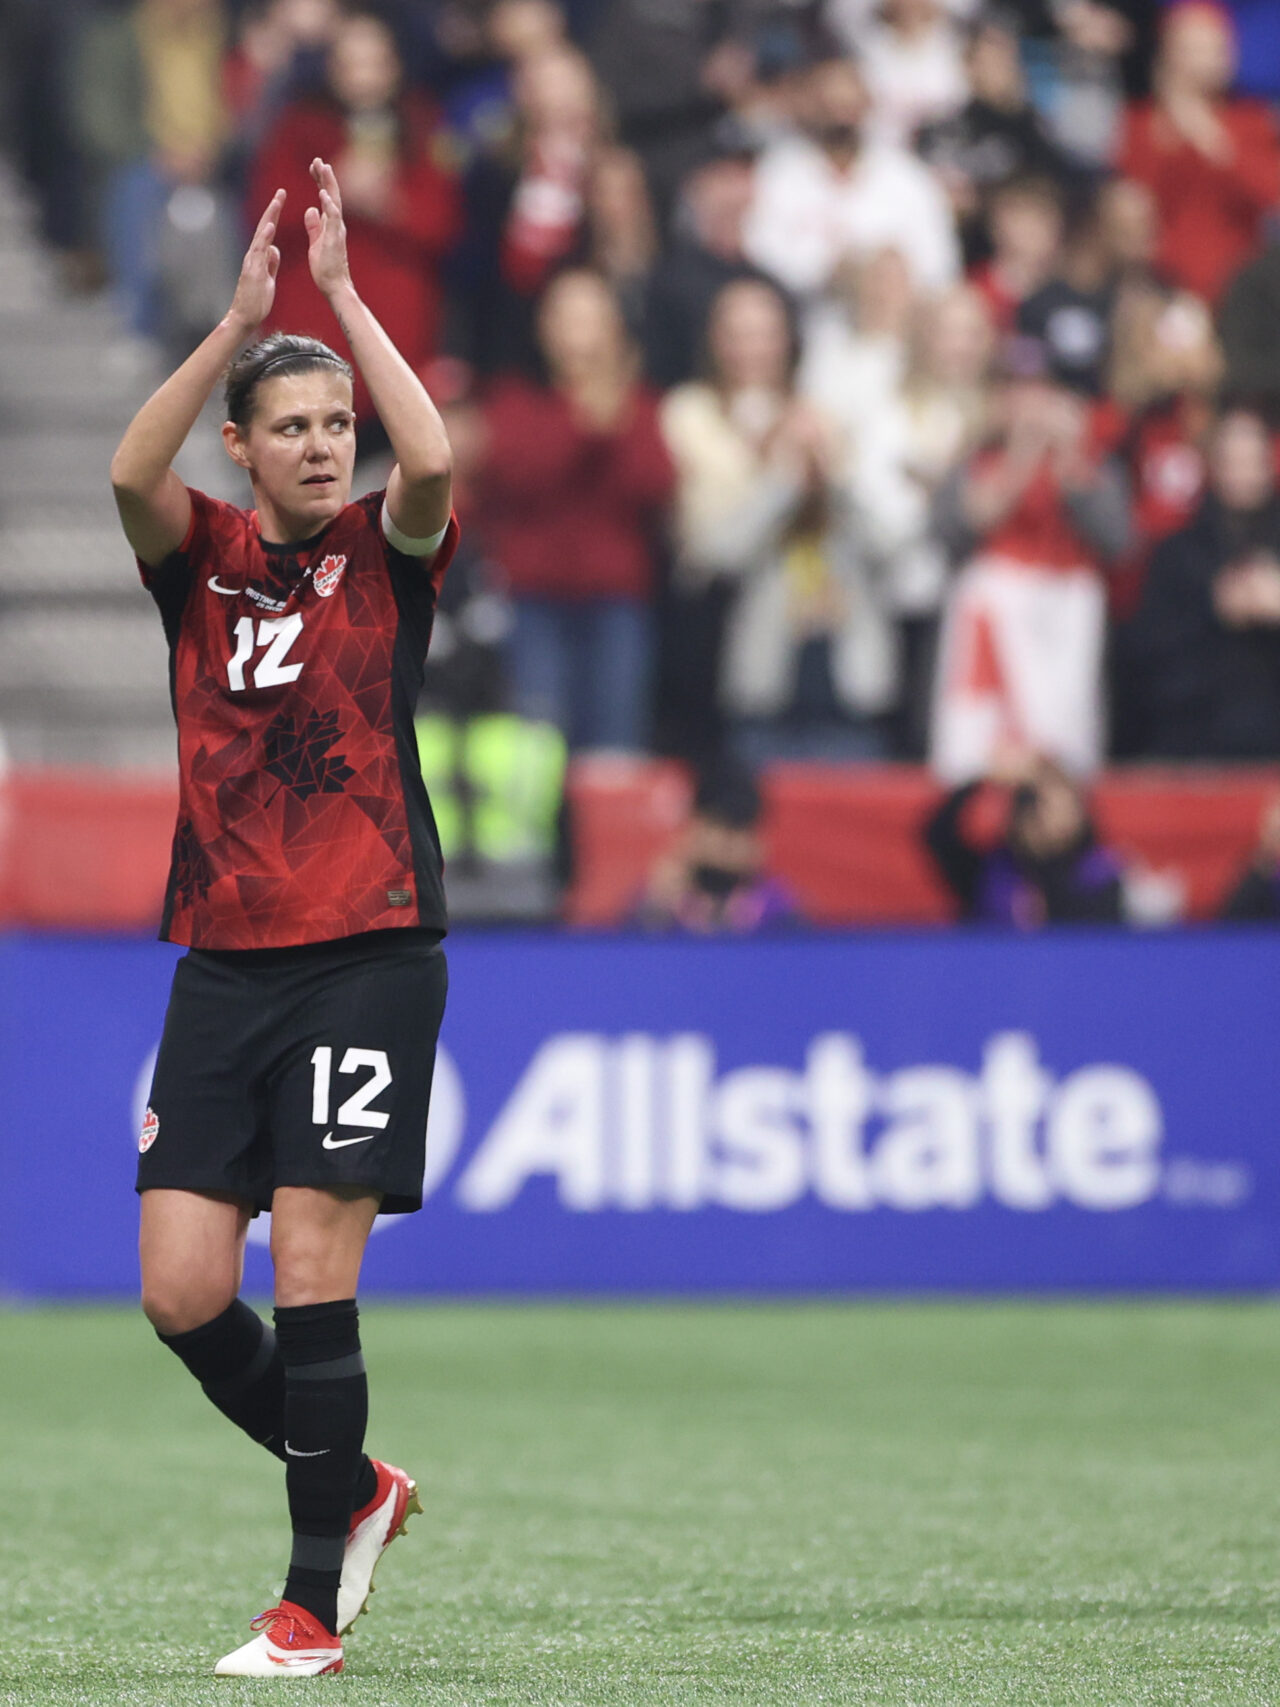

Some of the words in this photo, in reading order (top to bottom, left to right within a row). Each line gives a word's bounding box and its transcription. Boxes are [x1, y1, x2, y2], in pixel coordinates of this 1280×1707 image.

[227, 612, 304, 691] 12
[310, 1046, 393, 1129] 12
[455, 1030, 1163, 1212] Allstate
